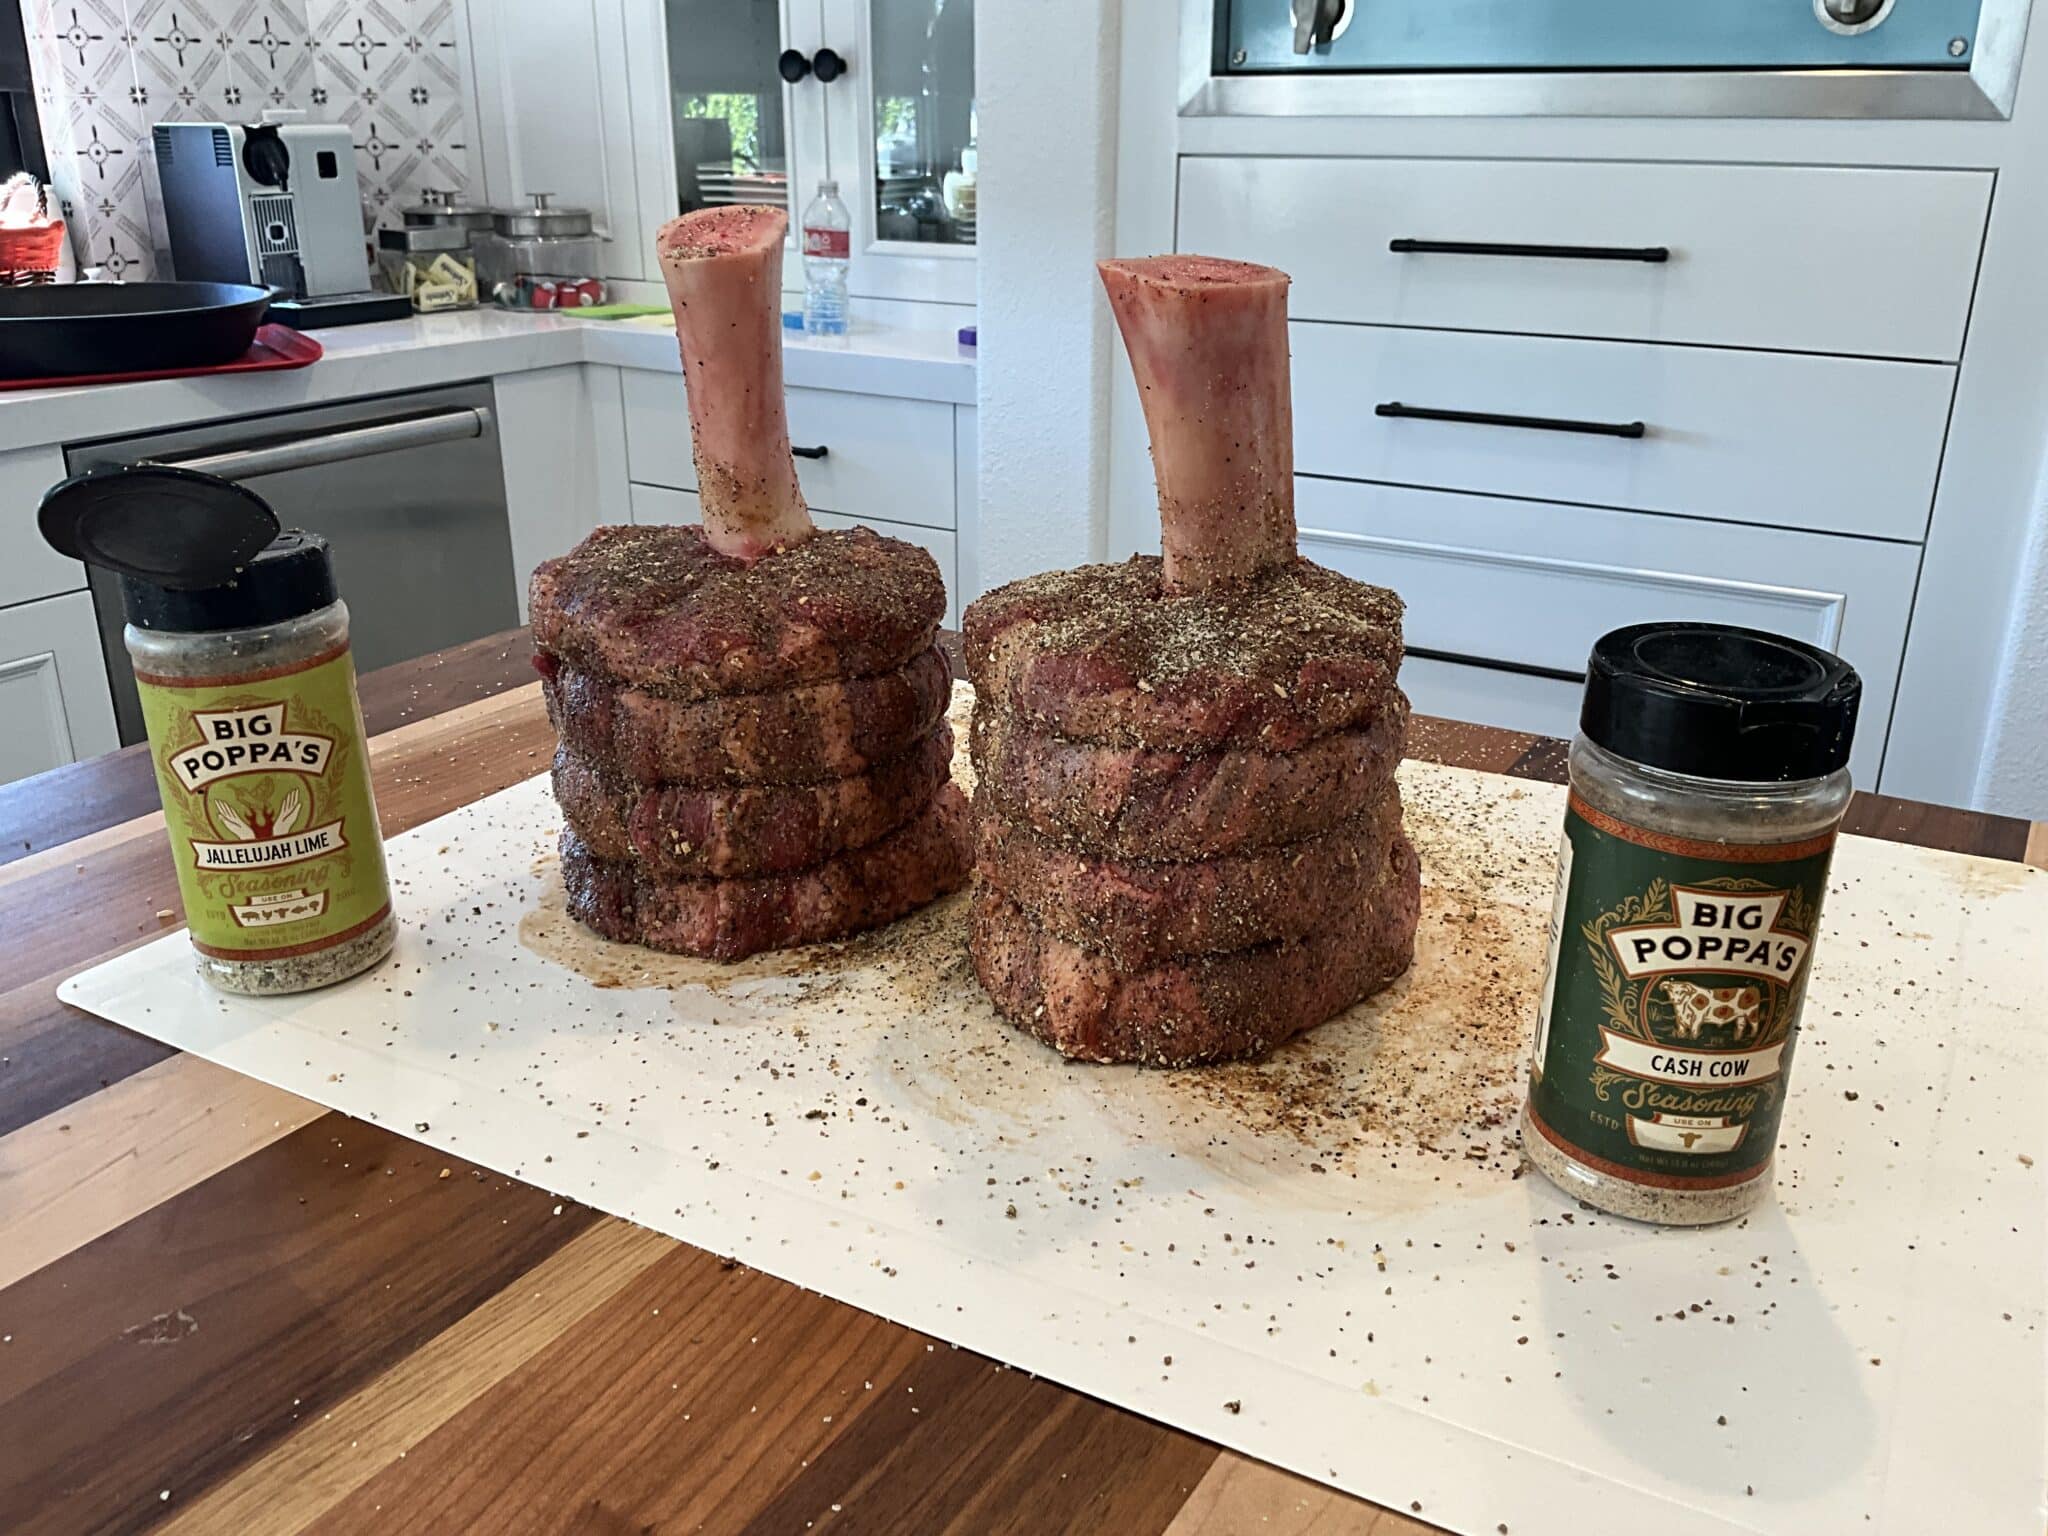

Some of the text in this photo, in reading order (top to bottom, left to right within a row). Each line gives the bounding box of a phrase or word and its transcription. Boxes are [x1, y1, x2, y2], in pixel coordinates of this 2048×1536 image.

[213, 715, 272, 740] BIG
[184, 741, 321, 779] POPPA'S
[206, 832, 329, 865] JALLELUJAH LIME
[219, 864, 331, 898] Seasoning
[1692, 901, 1763, 930] BIG
[1633, 935, 1797, 972] POPPA'S
[1651, 1055, 1750, 1078] CASH COW
[1622, 1081, 1759, 1118] Seasoning
[1590, 1110, 1619, 1130] ESTD
[1673, 1118, 1693, 1126] USE
